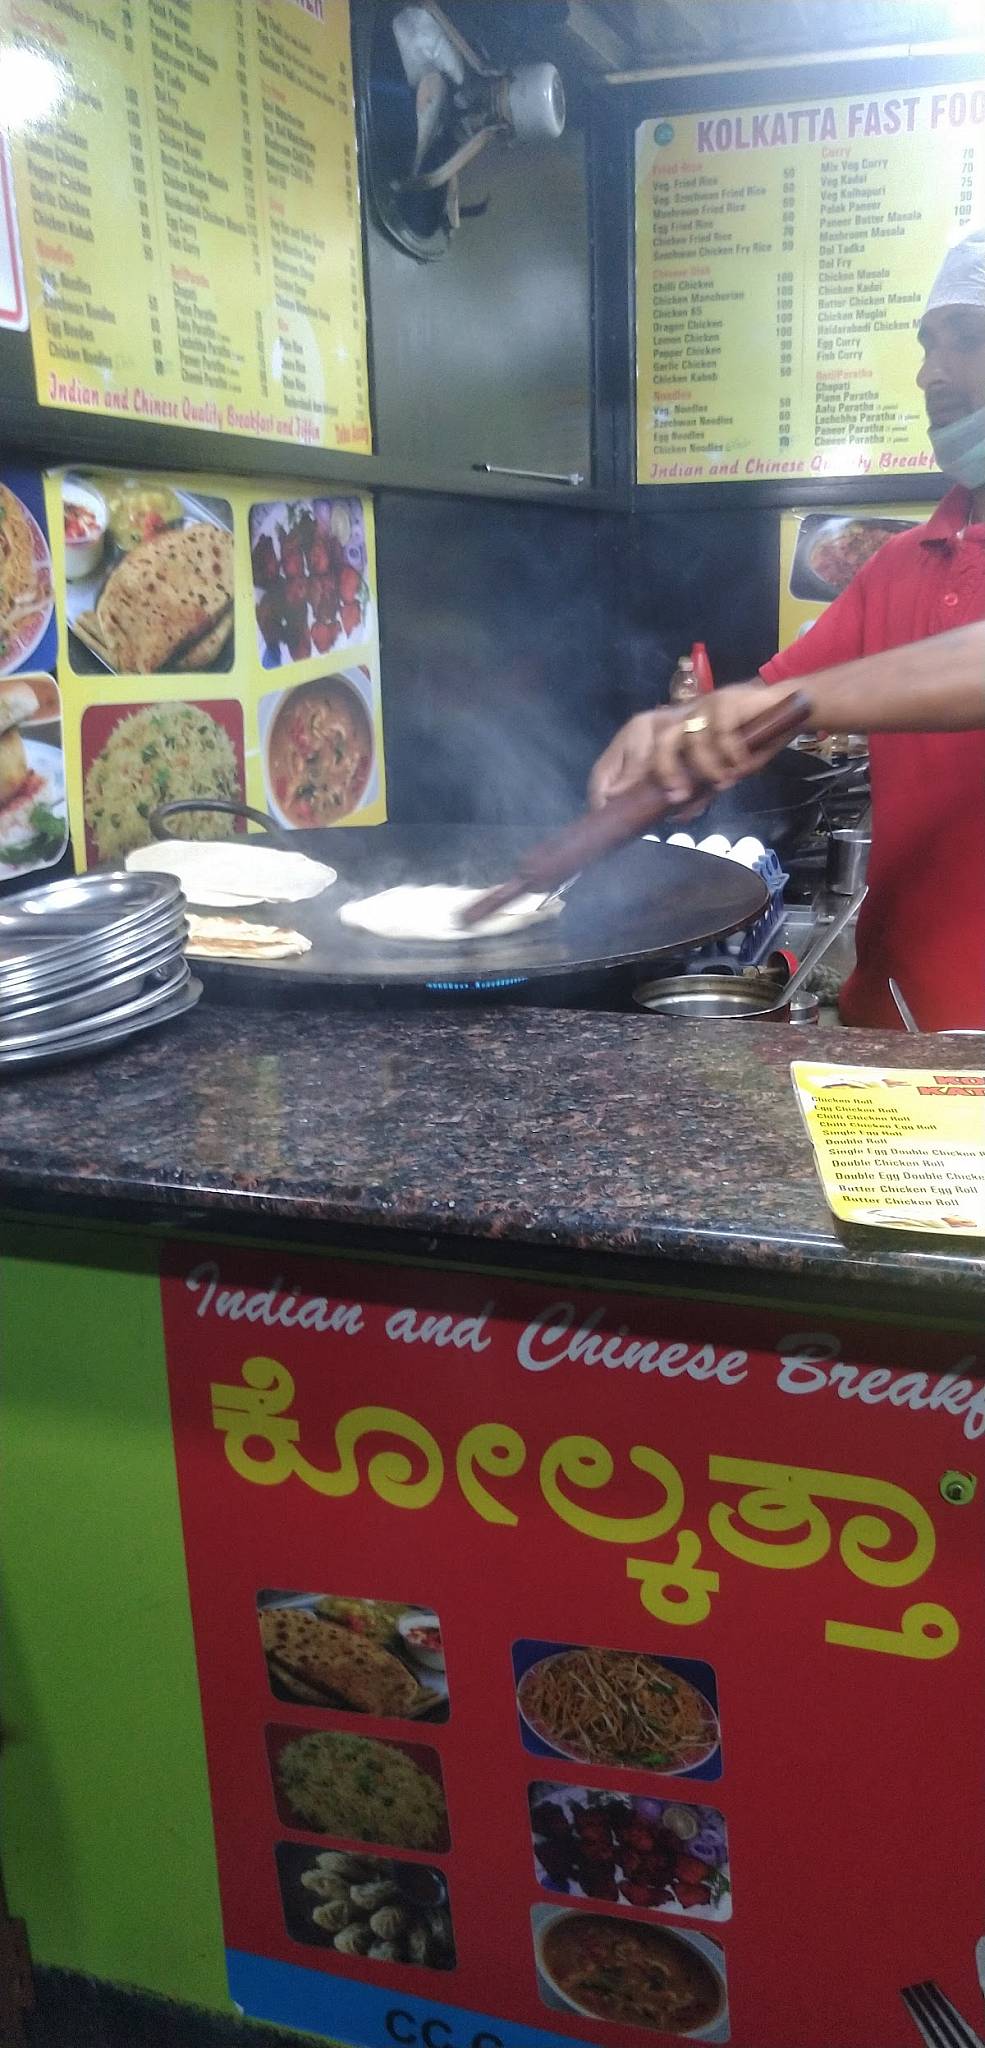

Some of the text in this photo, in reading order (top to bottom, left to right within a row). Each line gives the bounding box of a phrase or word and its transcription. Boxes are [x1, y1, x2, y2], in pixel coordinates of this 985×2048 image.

[697, 107, 836, 153] KOLKATTA
[848, 98, 920, 138] FAST
[841, 161, 859, 172] Veg
[862, 159, 888, 169] Curry
[821, 177, 838, 187] Veg
[841, 175, 867, 184] Kadai
[821, 191, 838, 202] Veg
[849, 202, 881, 212] Paneer
[855, 215, 884, 225] Butter
[888, 211, 922, 222] Masala
[954, 205, 971, 216] 100
[871, 226, 905, 237] Masala
[699, 243, 772, 257] Chicken Fry Rice
[837, 259, 852, 268] Fry
[819, 269, 890, 282] Chicken Masala
[678, 280, 714, 291] Chicken
[819, 285, 854, 295] Chicken
[653, 296, 688, 306] Chicken
[777, 286, 793, 296] 100
[849, 297, 884, 307] Chicken
[888, 292, 921, 303] Masala
[653, 309, 687, 320] Chicken
[777, 299, 793, 310] 100
[688, 320, 723, 330] Chicken
[777, 313, 792, 323] 100
[818, 312, 853, 322] Chicken
[874, 320, 909, 331] Chicken
[685, 334, 719, 343] Chicken
[776, 327, 792, 337] 100
[817, 337, 861, 349] Egg Curry
[686, 346, 721, 356] Chicken
[817, 350, 863, 360] Fish Curry
[682, 360, 716, 369] Chicken
[816, 382, 850, 392] Chapati
[50, 373, 99, 406] Indian
[105, 389, 128, 410] and
[134, 387, 178, 418] Chinese
[843, 391, 879, 402] Paratha
[838, 402, 874, 412] Paratha
[860, 413, 896, 422] Paratha
[849, 424, 884, 433] Paratha
[654, 433, 669, 443] Egg
[849, 435, 885, 444] Paratha
[650, 463, 703, 479] Indian
[709, 460, 739, 474] and
[746, 458, 804, 474] Chinese
[811, 1096, 872, 1105] Chicken Roll
[828, 1148, 864, 1156] Single
[867, 1148, 887, 1156] Egg
[932, 1149, 976, 1157] Chicken
[832, 1159, 871, 1167] Double
[874, 1159, 919, 1167] Chicken
[836, 1172, 874, 1180] Double
[878, 1172, 900, 1181] Egg
[903, 1172, 943, 1180] Double
[839, 1184, 978, 1195] Butter Chicken Egg Roll
[842, 1195, 880, 1204] Butter
[935, 1198, 959, 1206] Roll
[184, 1259, 365, 1336] Indian
[384, 1305, 492, 1354] and
[515, 1300, 750, 1387] Chinese
[209, 1355, 961, 1662] ಕೋಲ್ಕತ್ತಾ
